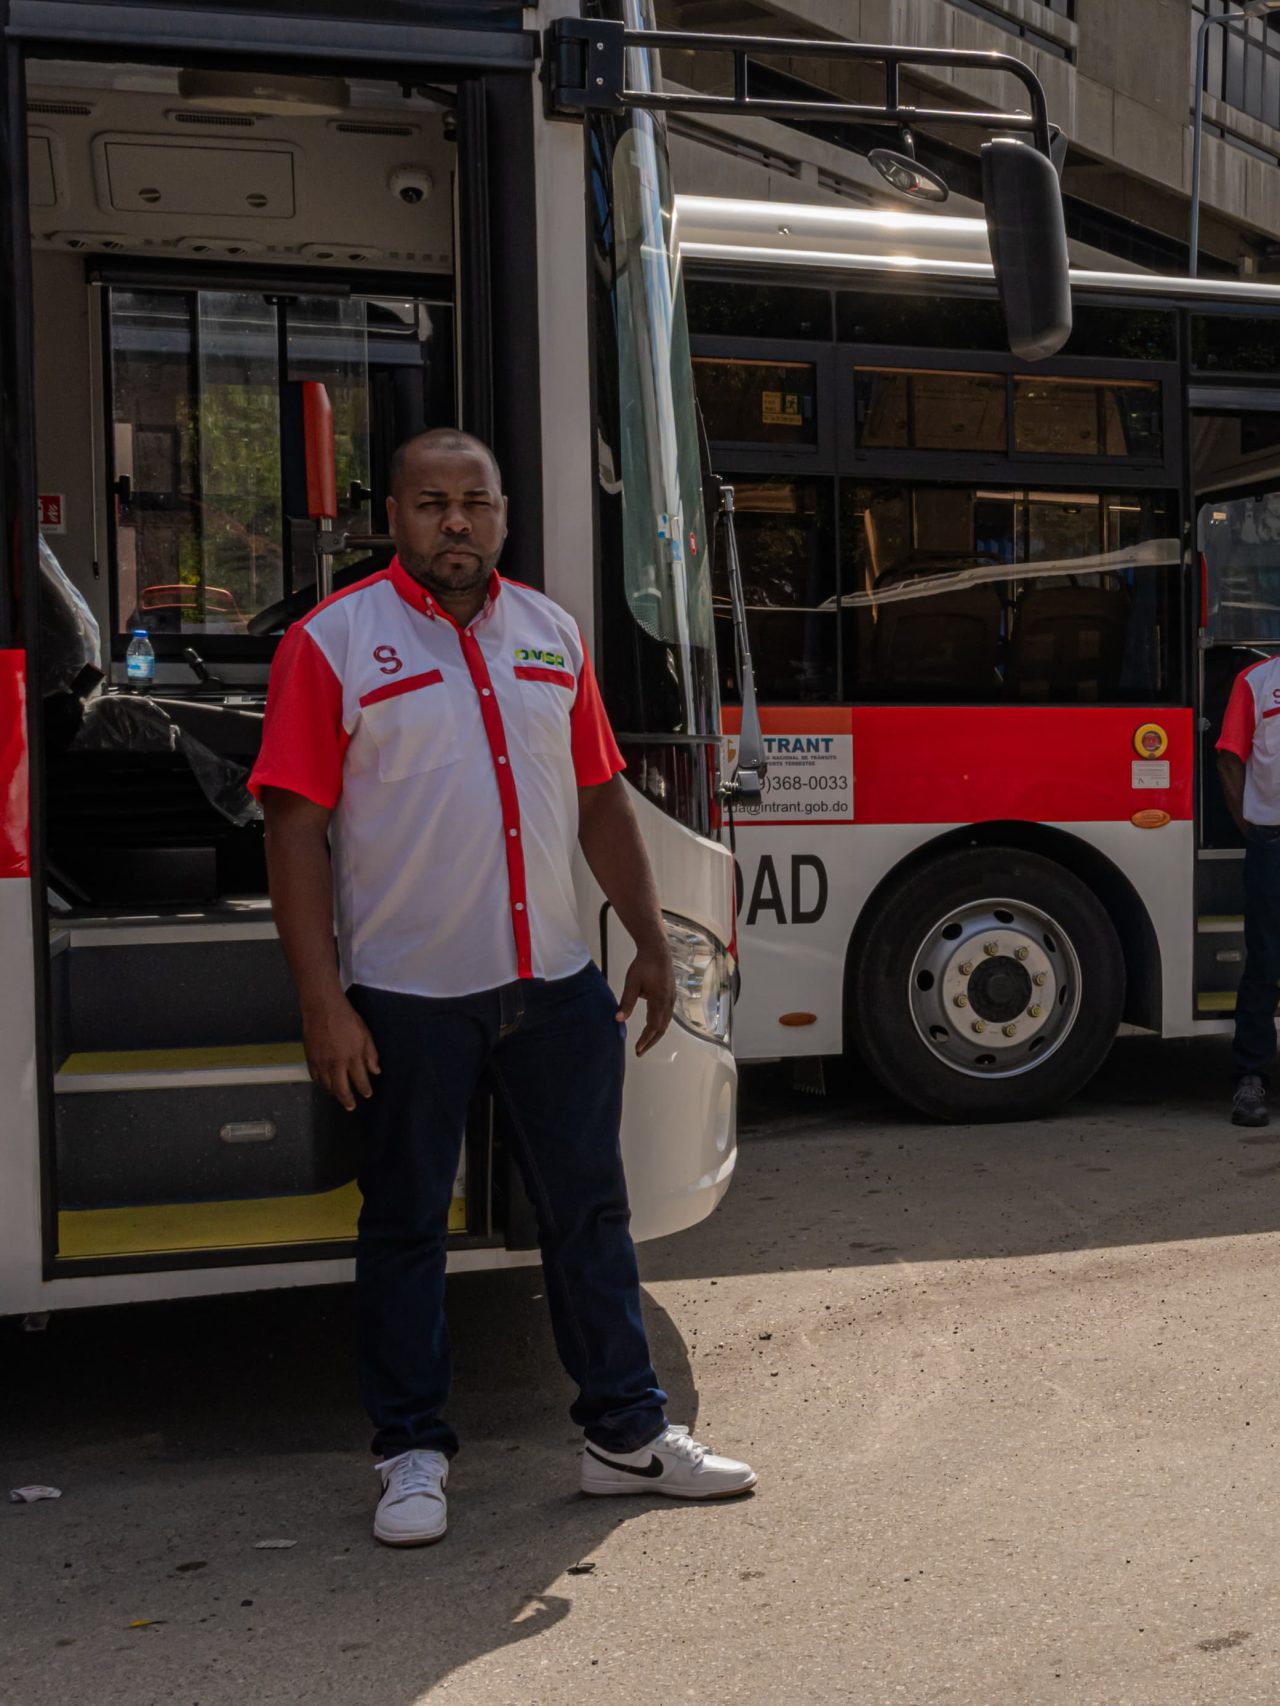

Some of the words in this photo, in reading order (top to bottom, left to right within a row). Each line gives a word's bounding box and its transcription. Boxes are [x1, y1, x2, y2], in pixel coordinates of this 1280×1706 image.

[373, 645, 403, 675] S
[514, 648, 565, 668] OMSA
[764, 738, 834, 753] TRANT
[759, 776, 848, 793] 9)368-0033
[735, 854, 828, 925] AD
